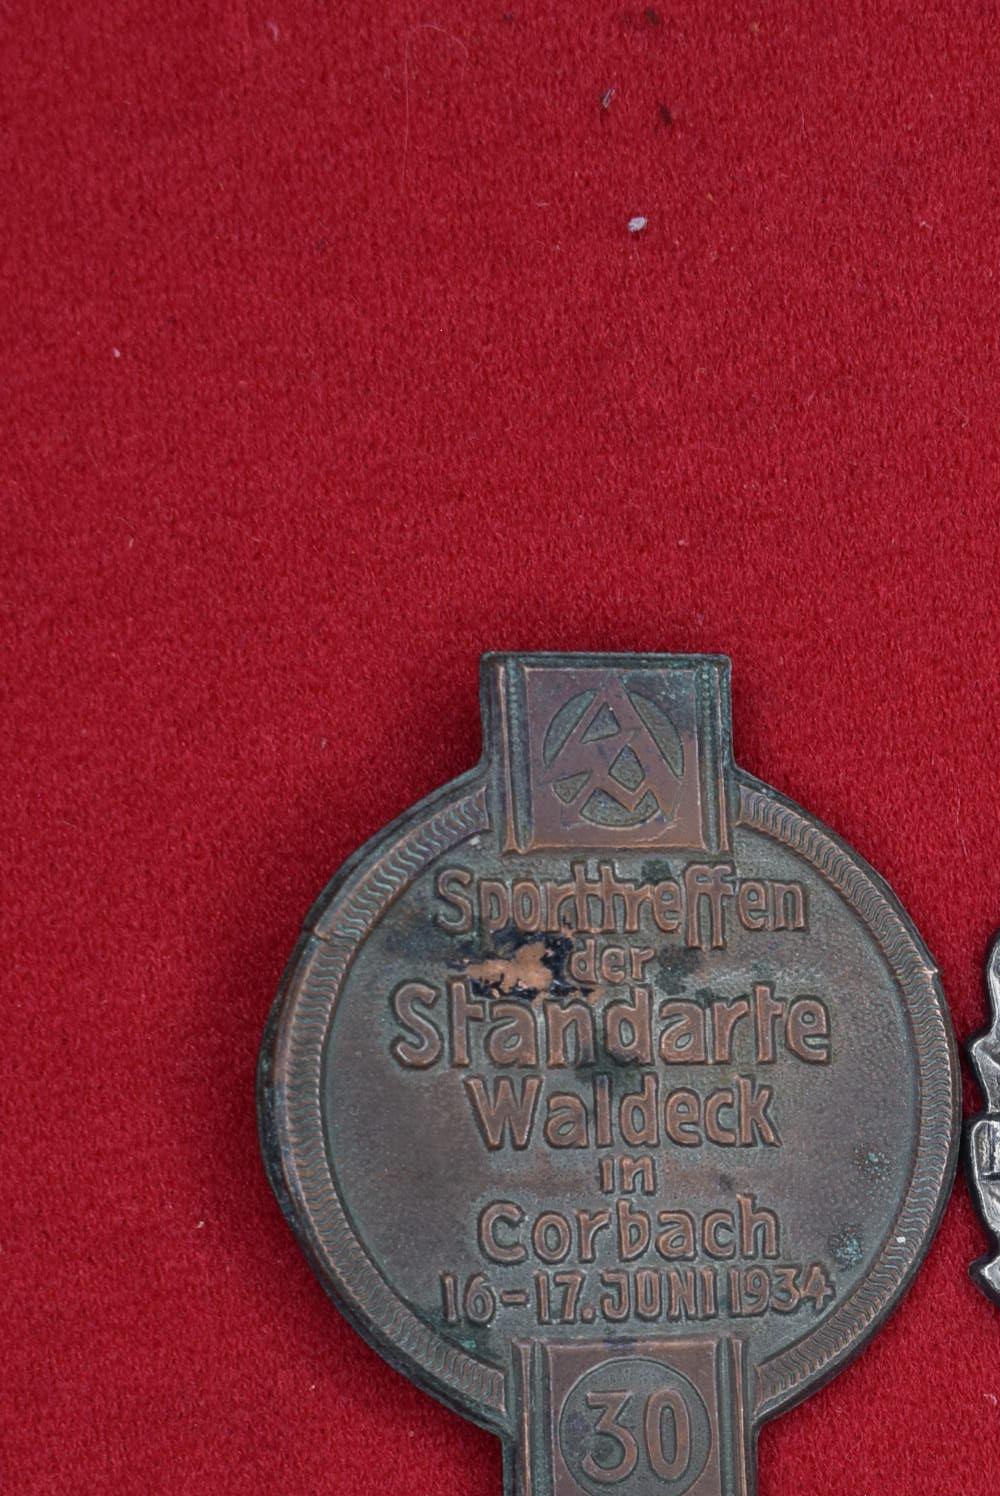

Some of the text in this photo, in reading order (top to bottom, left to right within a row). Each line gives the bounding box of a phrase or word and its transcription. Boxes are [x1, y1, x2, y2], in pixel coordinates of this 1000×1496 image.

[434, 861, 810, 951] Sporttreffen
[569, 939, 655, 985] der
[390, 982, 833, 1069] Standarte
[464, 1076, 782, 1149] Waldeck
[478, 1196, 781, 1264] Corbach
[729, 1261, 834, 1317] 1934
[582, 1390, 692, 1483] 30
